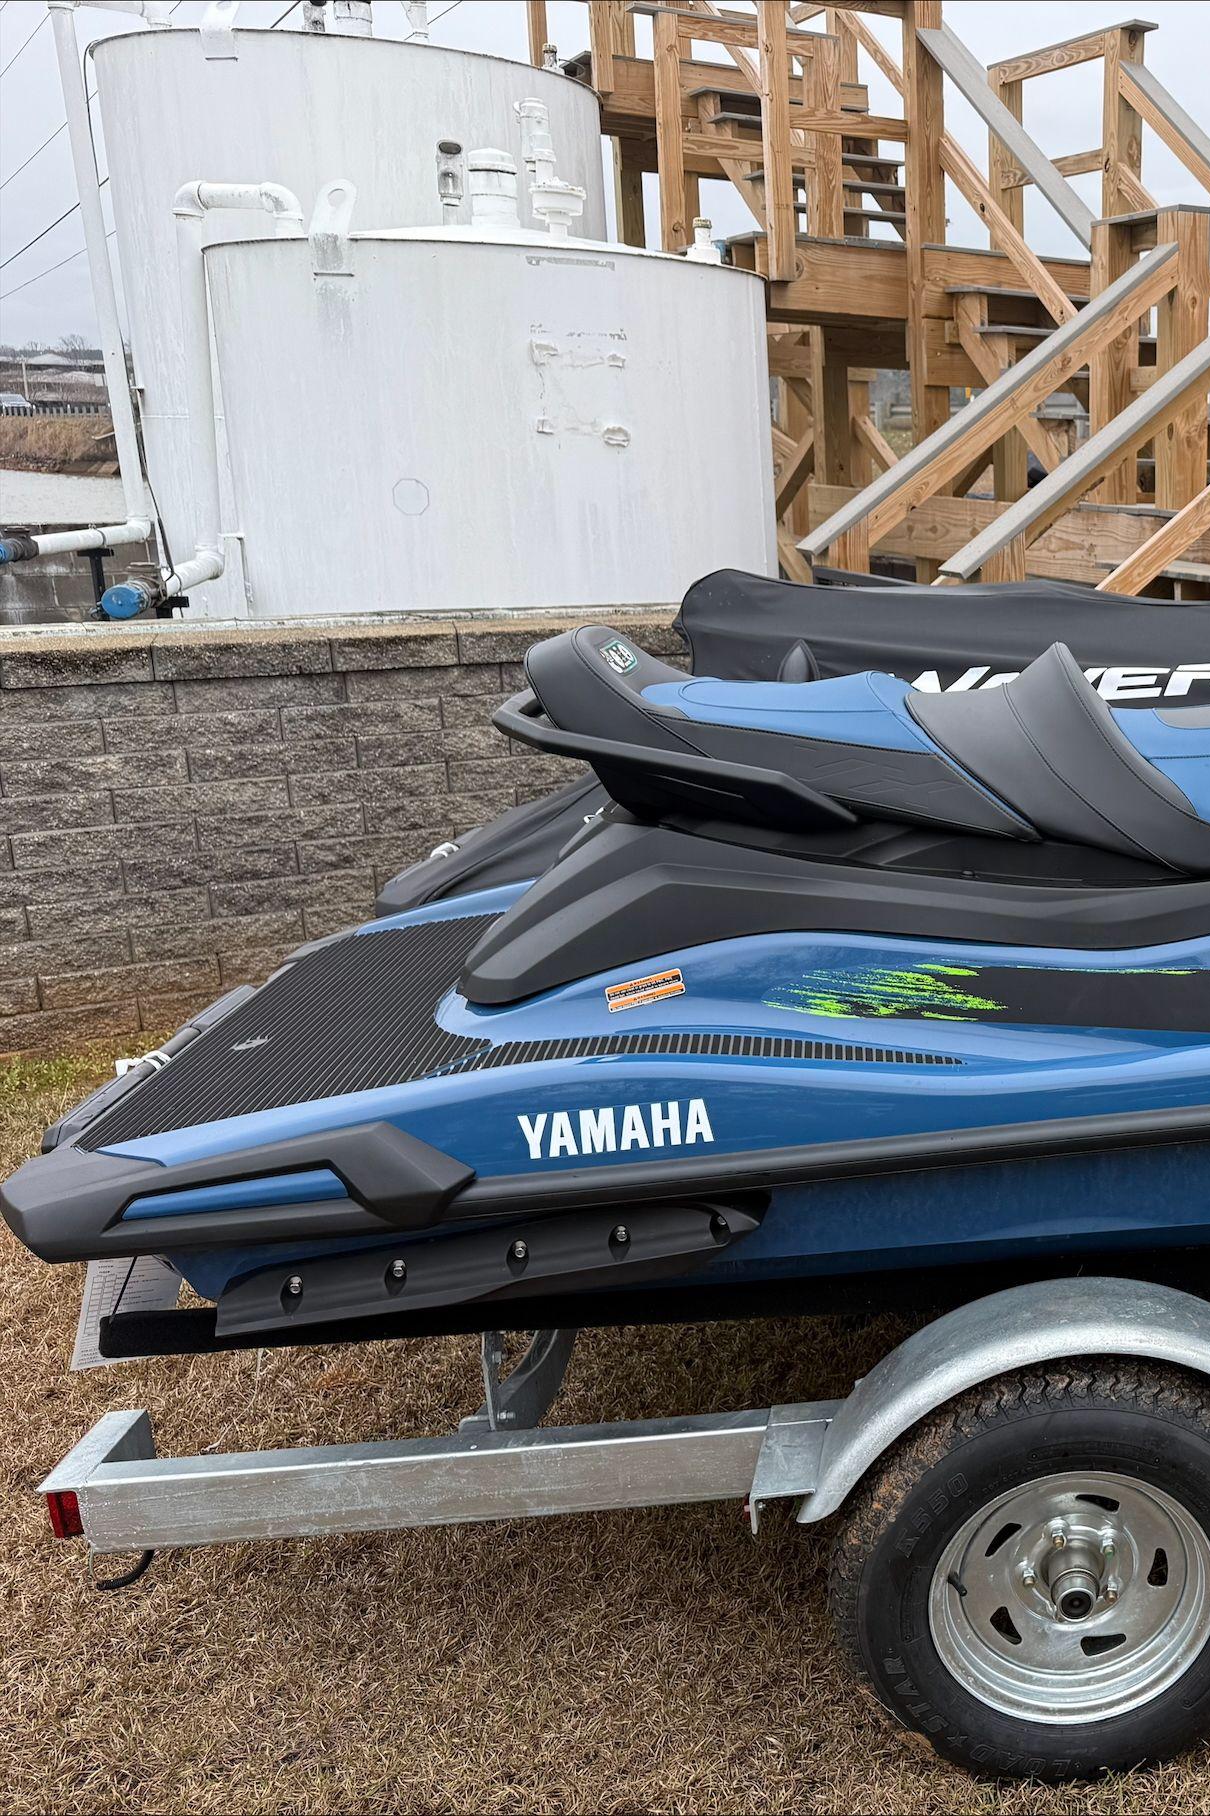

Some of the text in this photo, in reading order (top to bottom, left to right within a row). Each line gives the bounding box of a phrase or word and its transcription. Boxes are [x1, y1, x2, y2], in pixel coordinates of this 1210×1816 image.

[517, 1098, 715, 1160] YAMAHA
[881, 1656, 1072, 1777] LOAD STAR
